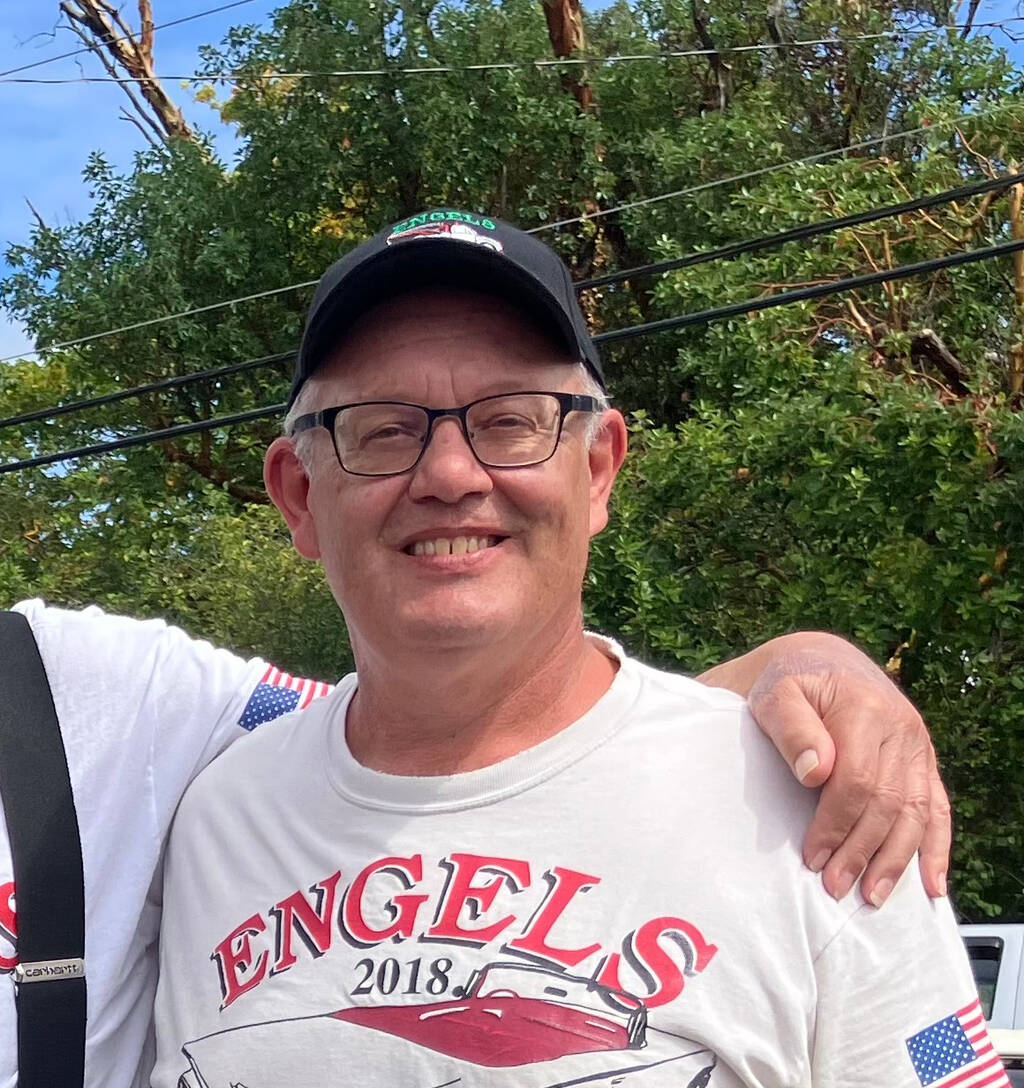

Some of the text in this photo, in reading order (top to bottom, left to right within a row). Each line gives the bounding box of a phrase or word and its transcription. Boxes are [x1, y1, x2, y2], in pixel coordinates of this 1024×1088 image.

[392, 211, 496, 234] ENGELS
[211, 853, 719, 1012] ENGELS
[351, 957, 453, 996] 2018
